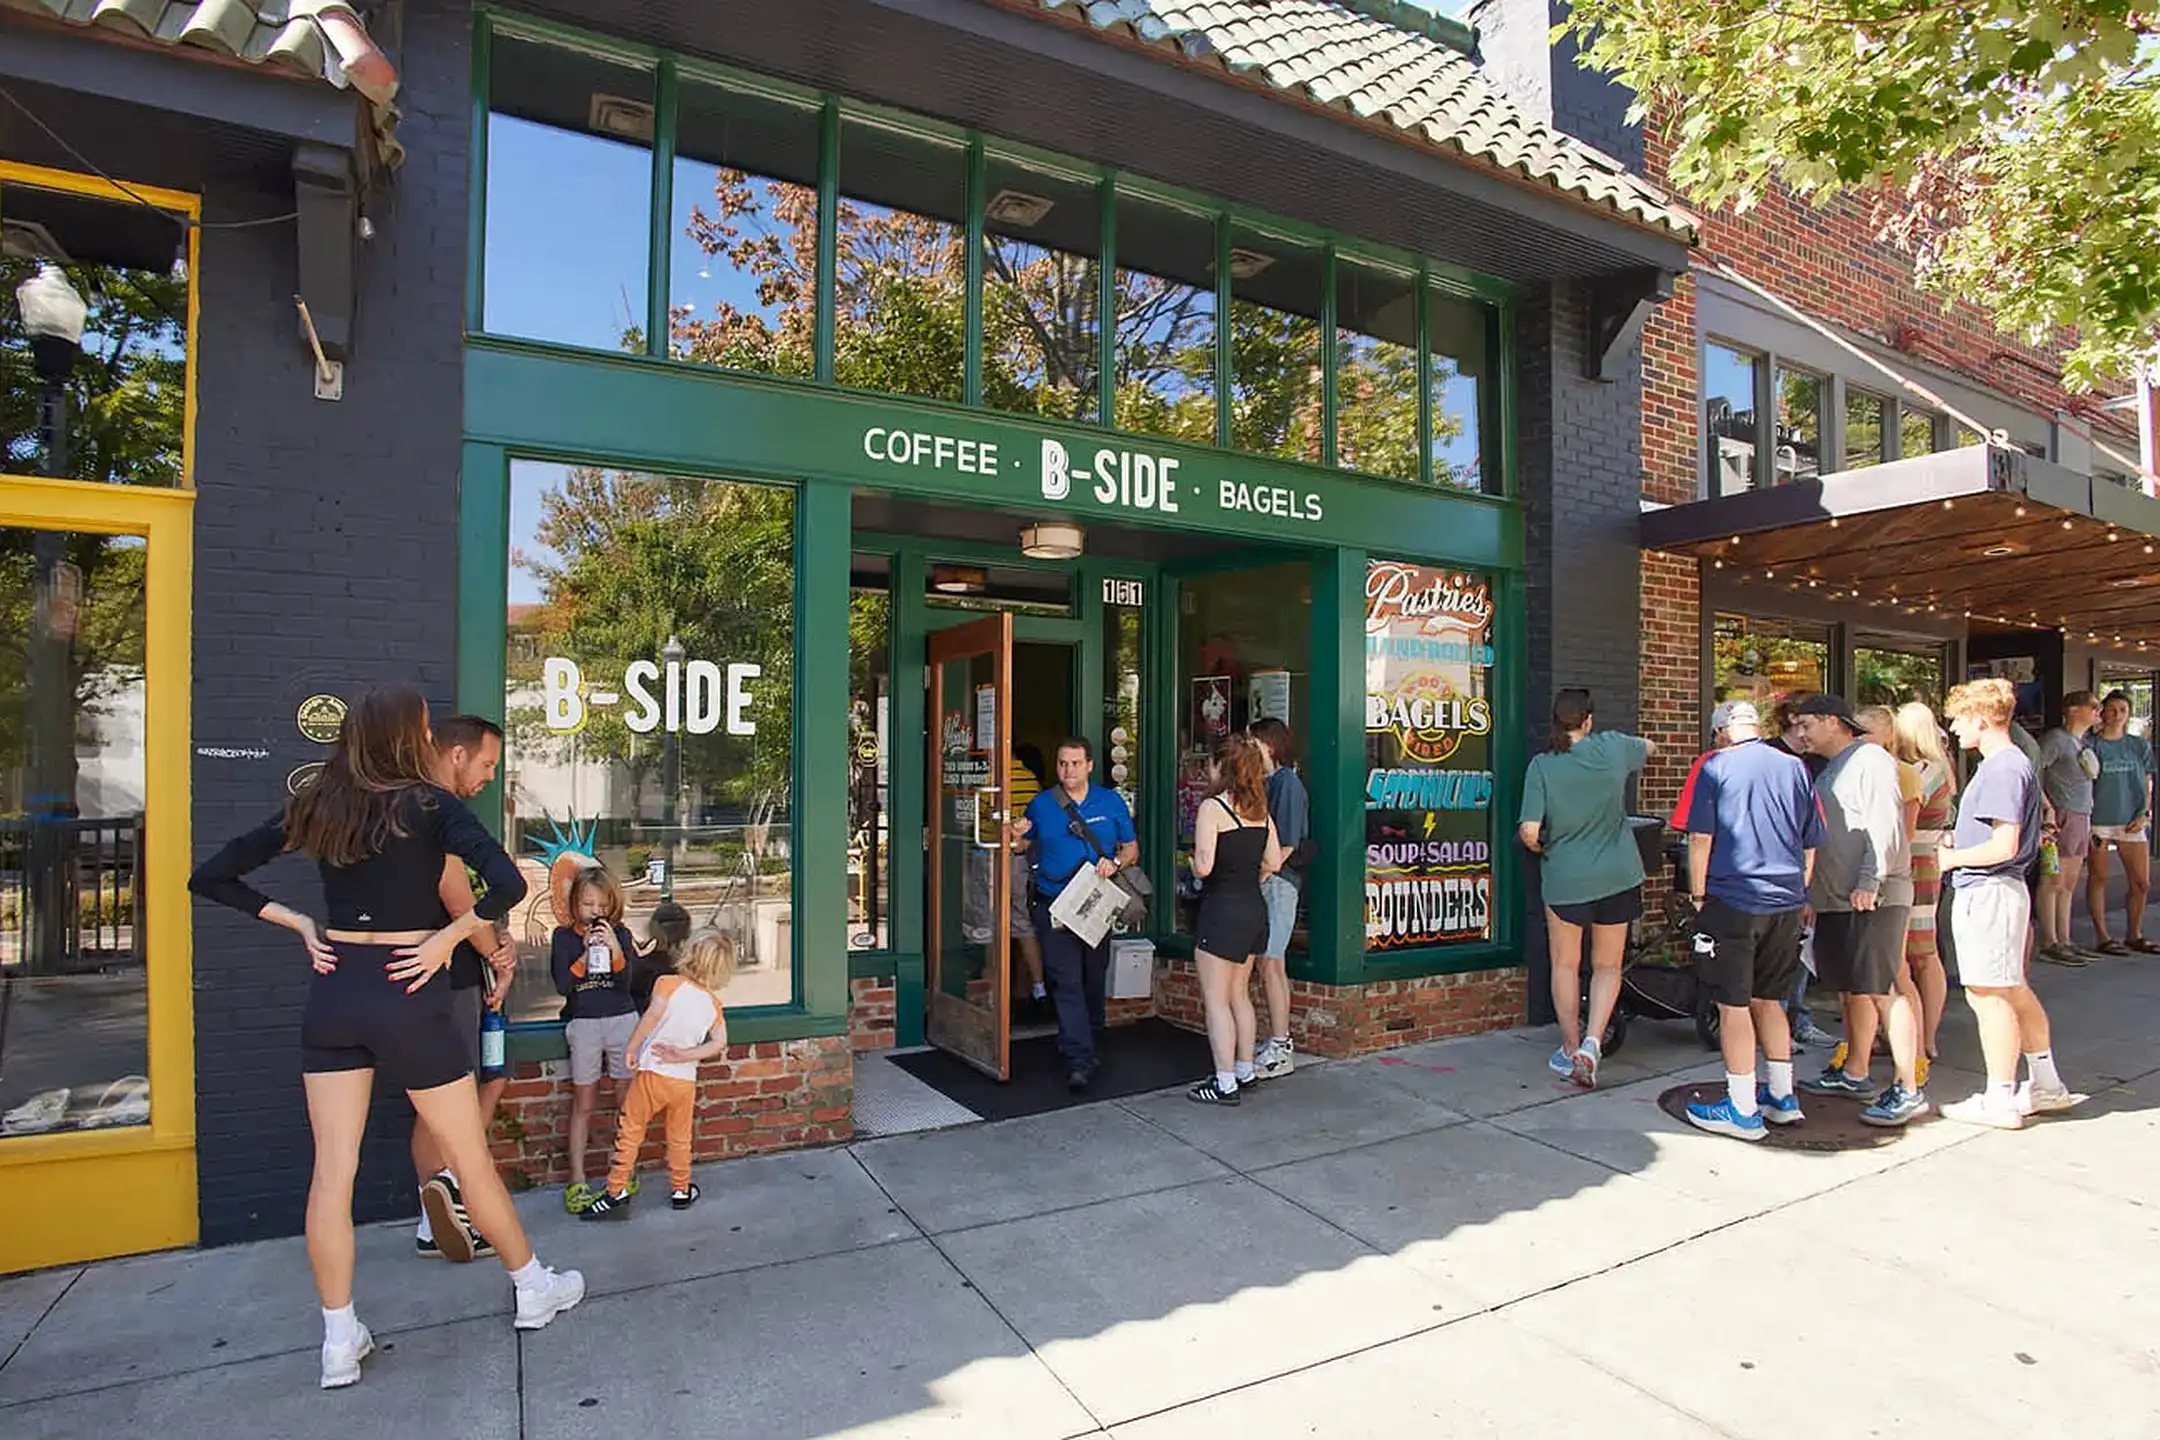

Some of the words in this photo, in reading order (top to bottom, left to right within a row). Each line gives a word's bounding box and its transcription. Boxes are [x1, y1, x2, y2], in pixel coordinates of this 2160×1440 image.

[864, 427, 998, 475] COFFEE
[1041, 438, 1180, 513] B-SIDE
[1219, 479, 1324, 521] BAGELS
[1365, 565, 1490, 631] Pastries
[544, 657, 761, 735] B-SIDE
[1366, 695, 1488, 731] BAGELS
[1367, 843, 1419, 865] SOUP
[1427, 841, 1489, 863] SALAD
[1366, 877, 1489, 937] POUNDERS
